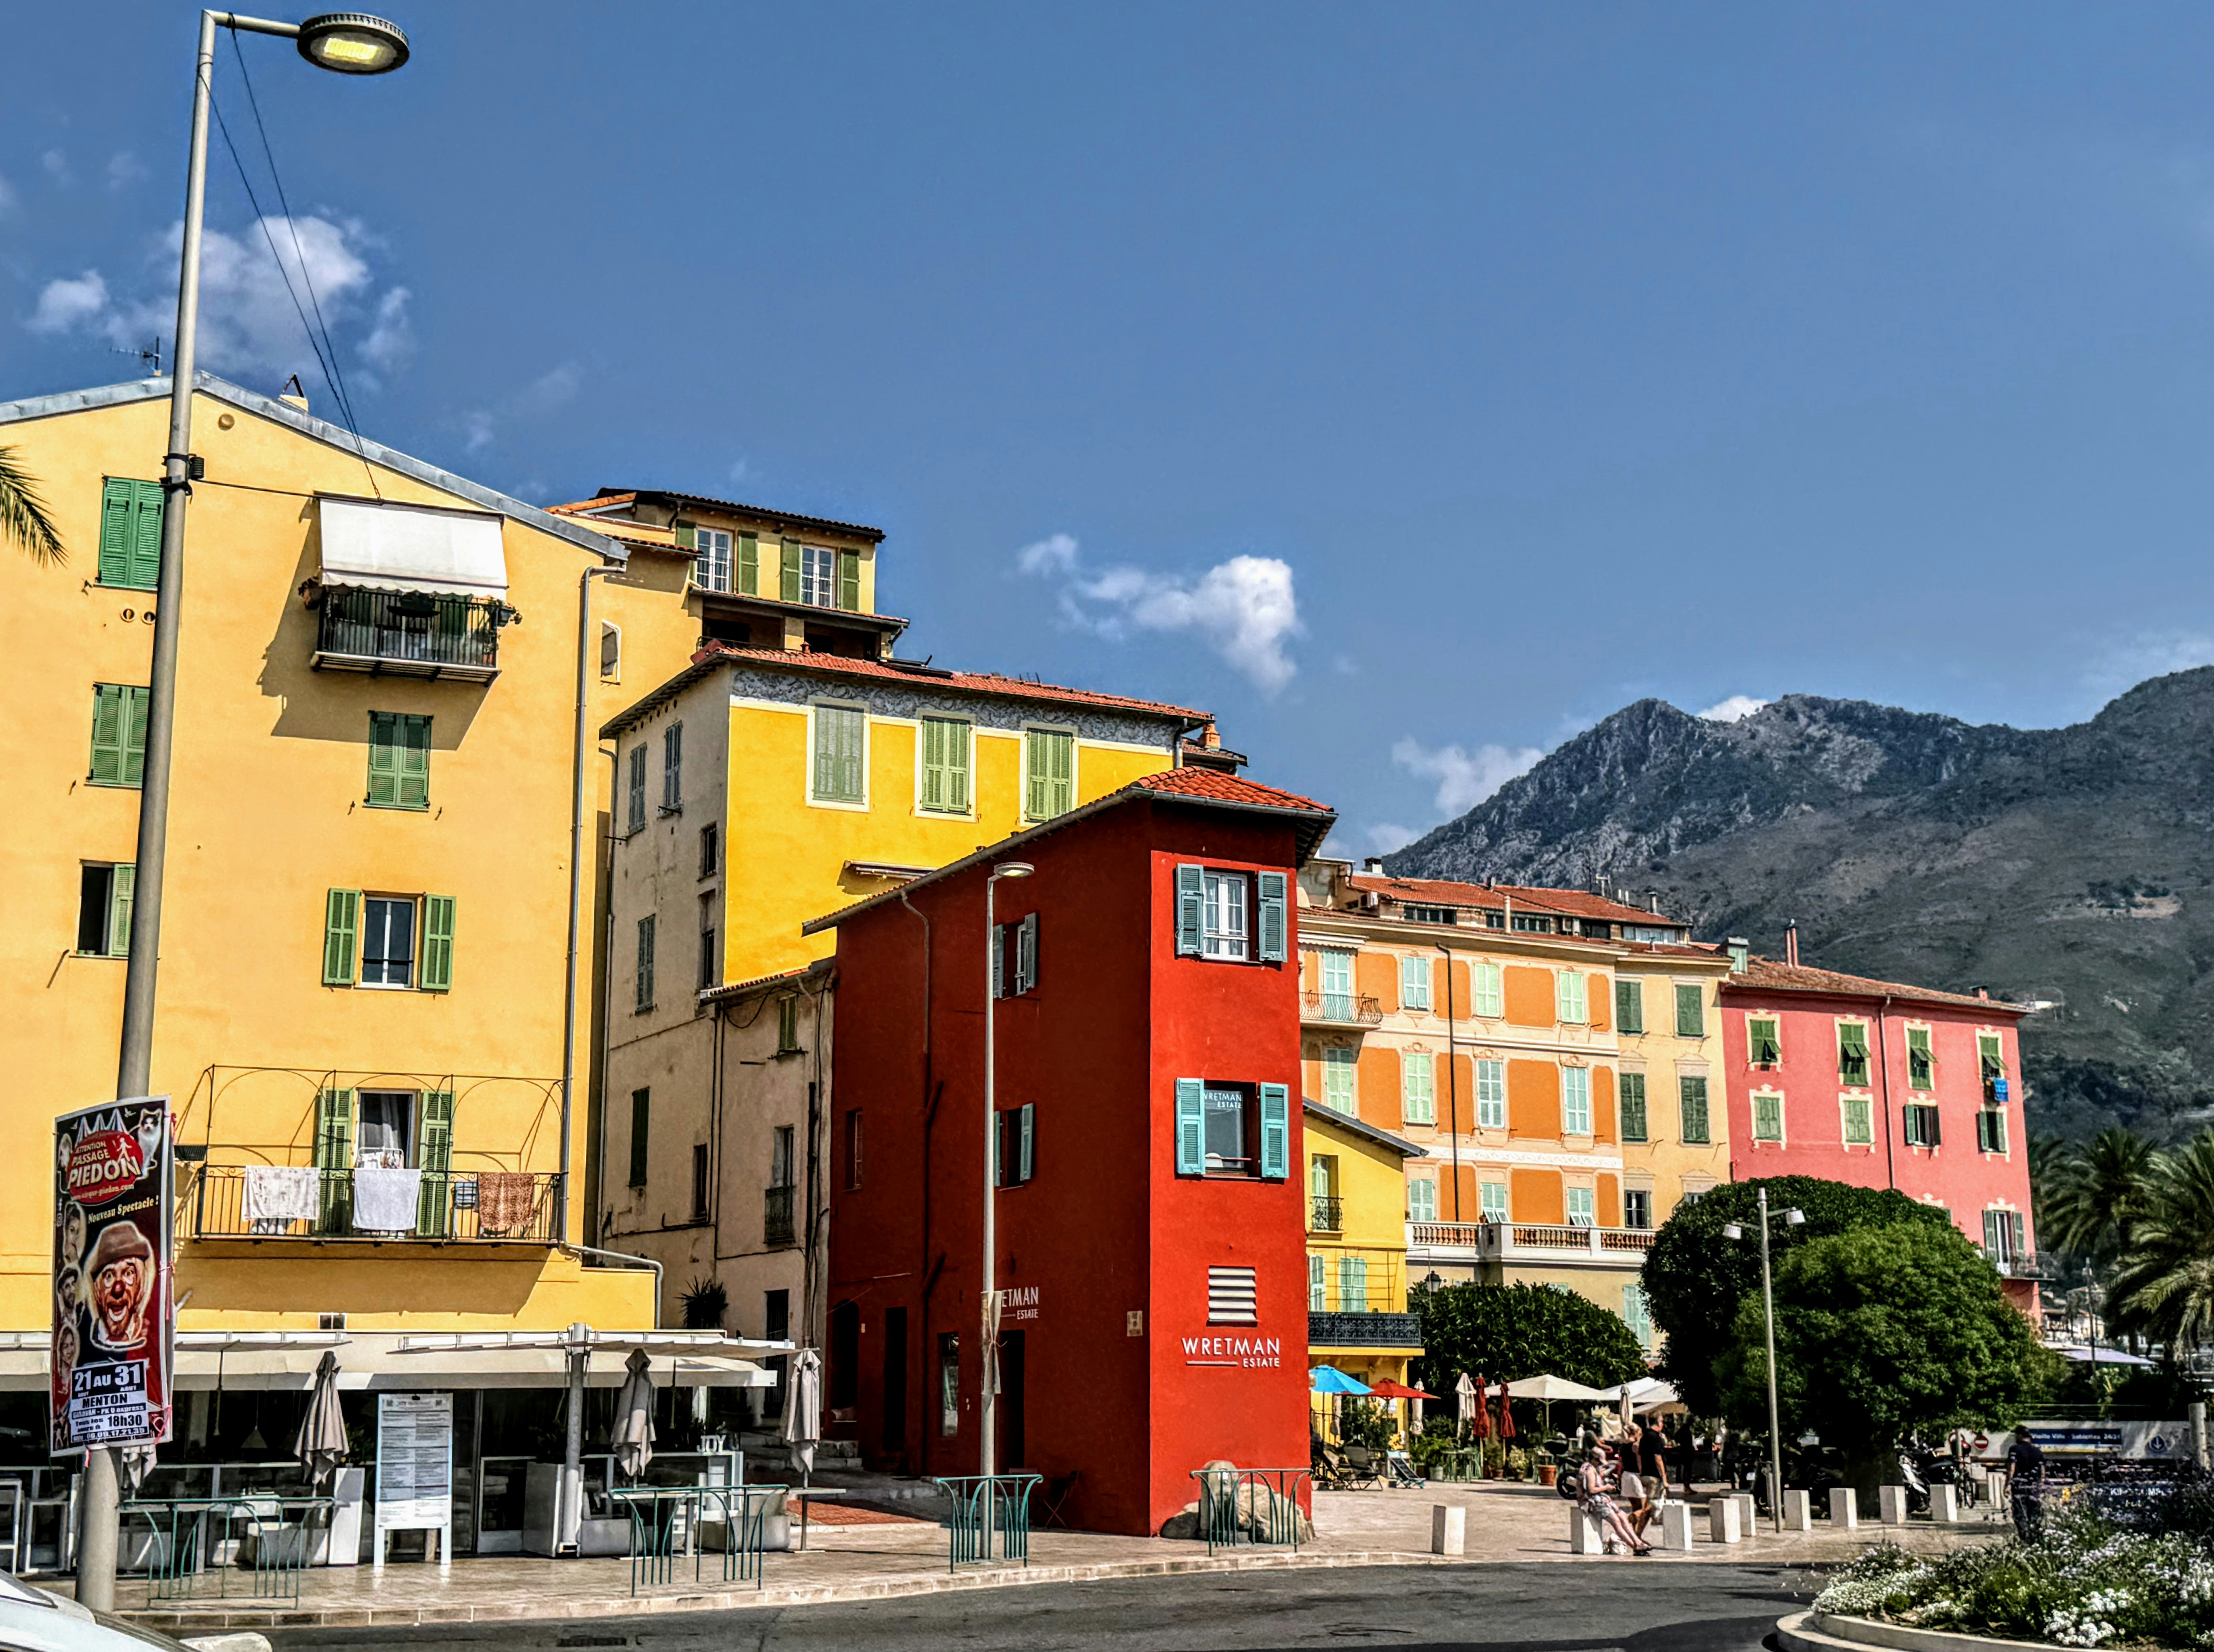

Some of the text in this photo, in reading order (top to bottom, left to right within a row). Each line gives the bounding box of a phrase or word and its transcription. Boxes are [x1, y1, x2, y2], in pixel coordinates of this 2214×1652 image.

[76, 1141, 106, 1154] ATTENTION
[72, 1149, 110, 1166] PASSAGE
[67, 1156, 141, 1190] PIEDON
[88, 1208, 116, 1224] Nouveau
[118, 1196, 154, 1216] Spectacle
[1002, 1287, 1039, 1307] ETMAN
[1017, 1309, 1039, 1320] ESTATE
[1182, 1337, 1280, 1356] WRETMAN
[1243, 1358, 1280, 1368] ESTATE
[74, 1364, 141, 1392] 21 AU 31
[82, 1393, 128, 1408] MENTON
[107, 1415, 142, 1427] 18h30
[697, 1434, 727, 1453] JOY
